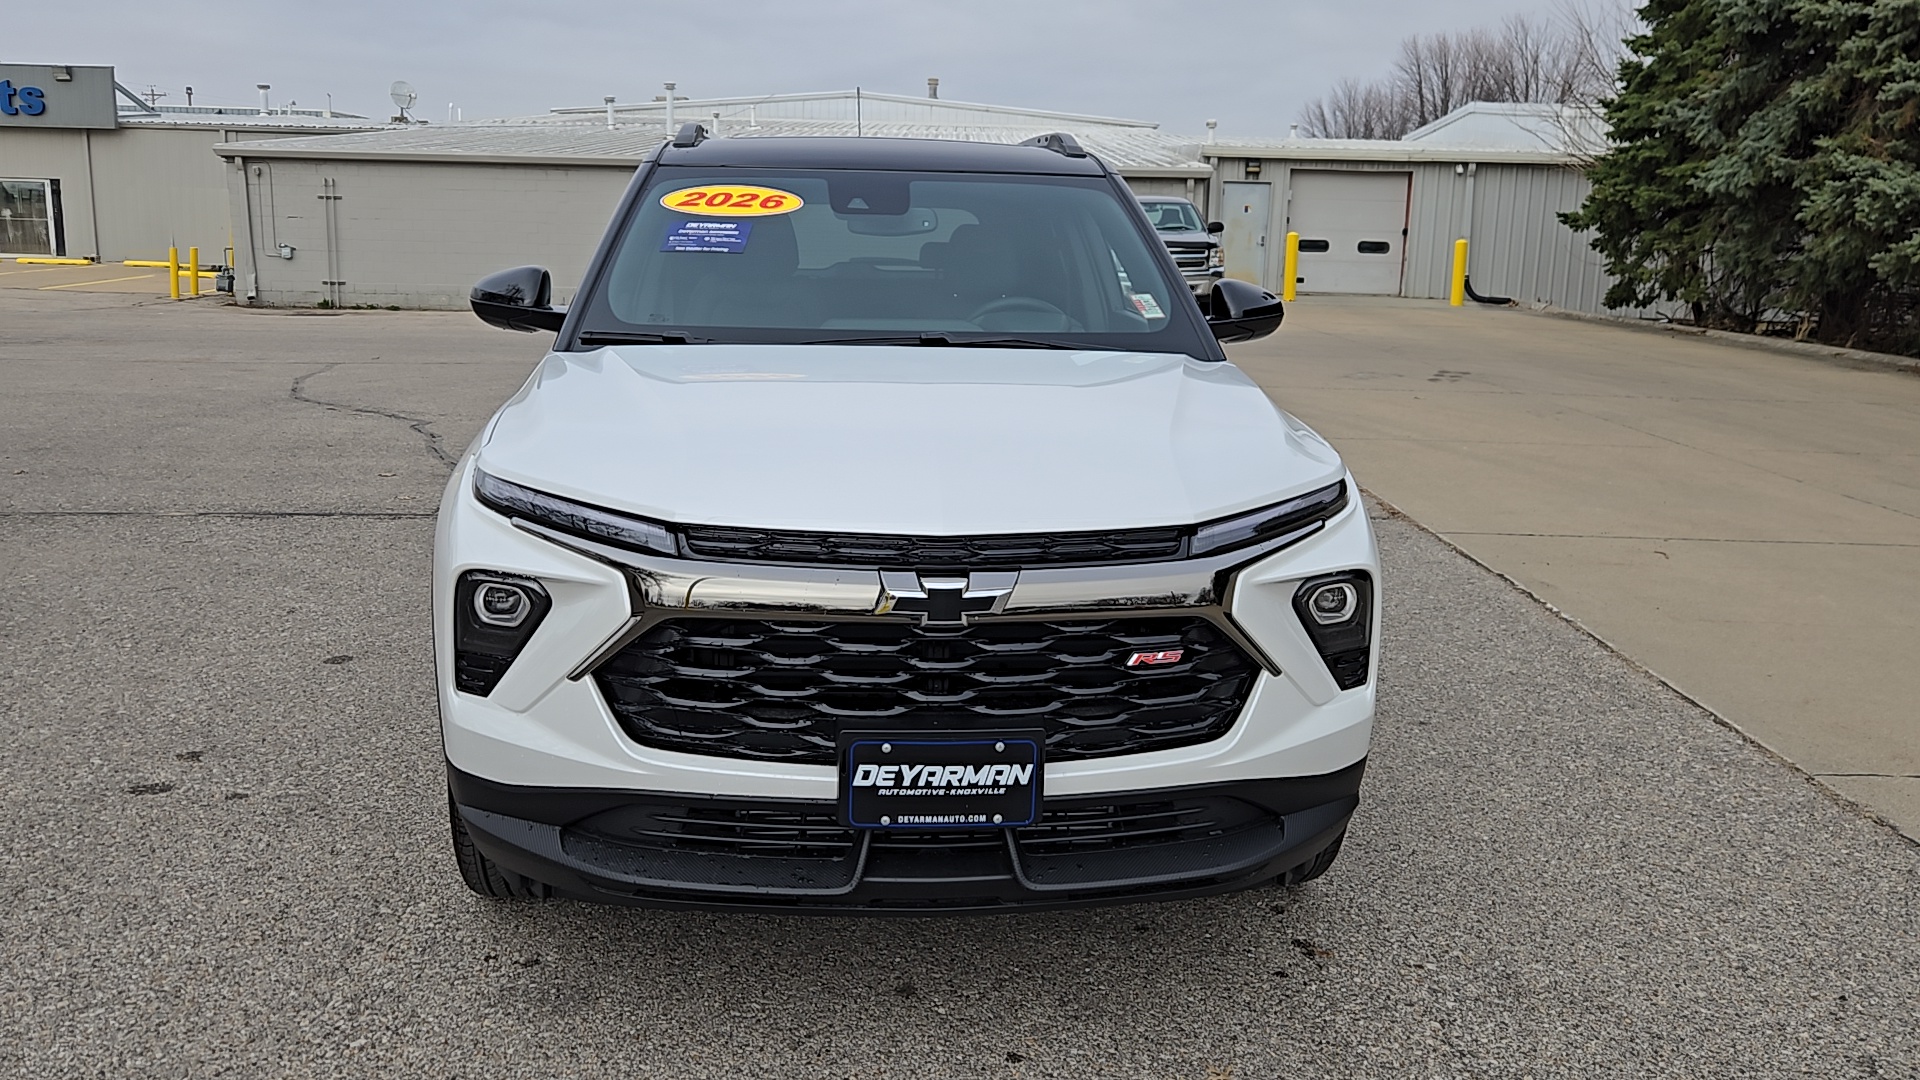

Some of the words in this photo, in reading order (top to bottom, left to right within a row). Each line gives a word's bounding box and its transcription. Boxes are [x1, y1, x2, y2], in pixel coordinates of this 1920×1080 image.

[675, 192, 788, 209] 2026
[1127, 650, 1184, 666] RS
[852, 764, 1034, 787] DEYARMAN
[898, 814, 987, 824] DEYARMANAUTO.COM
